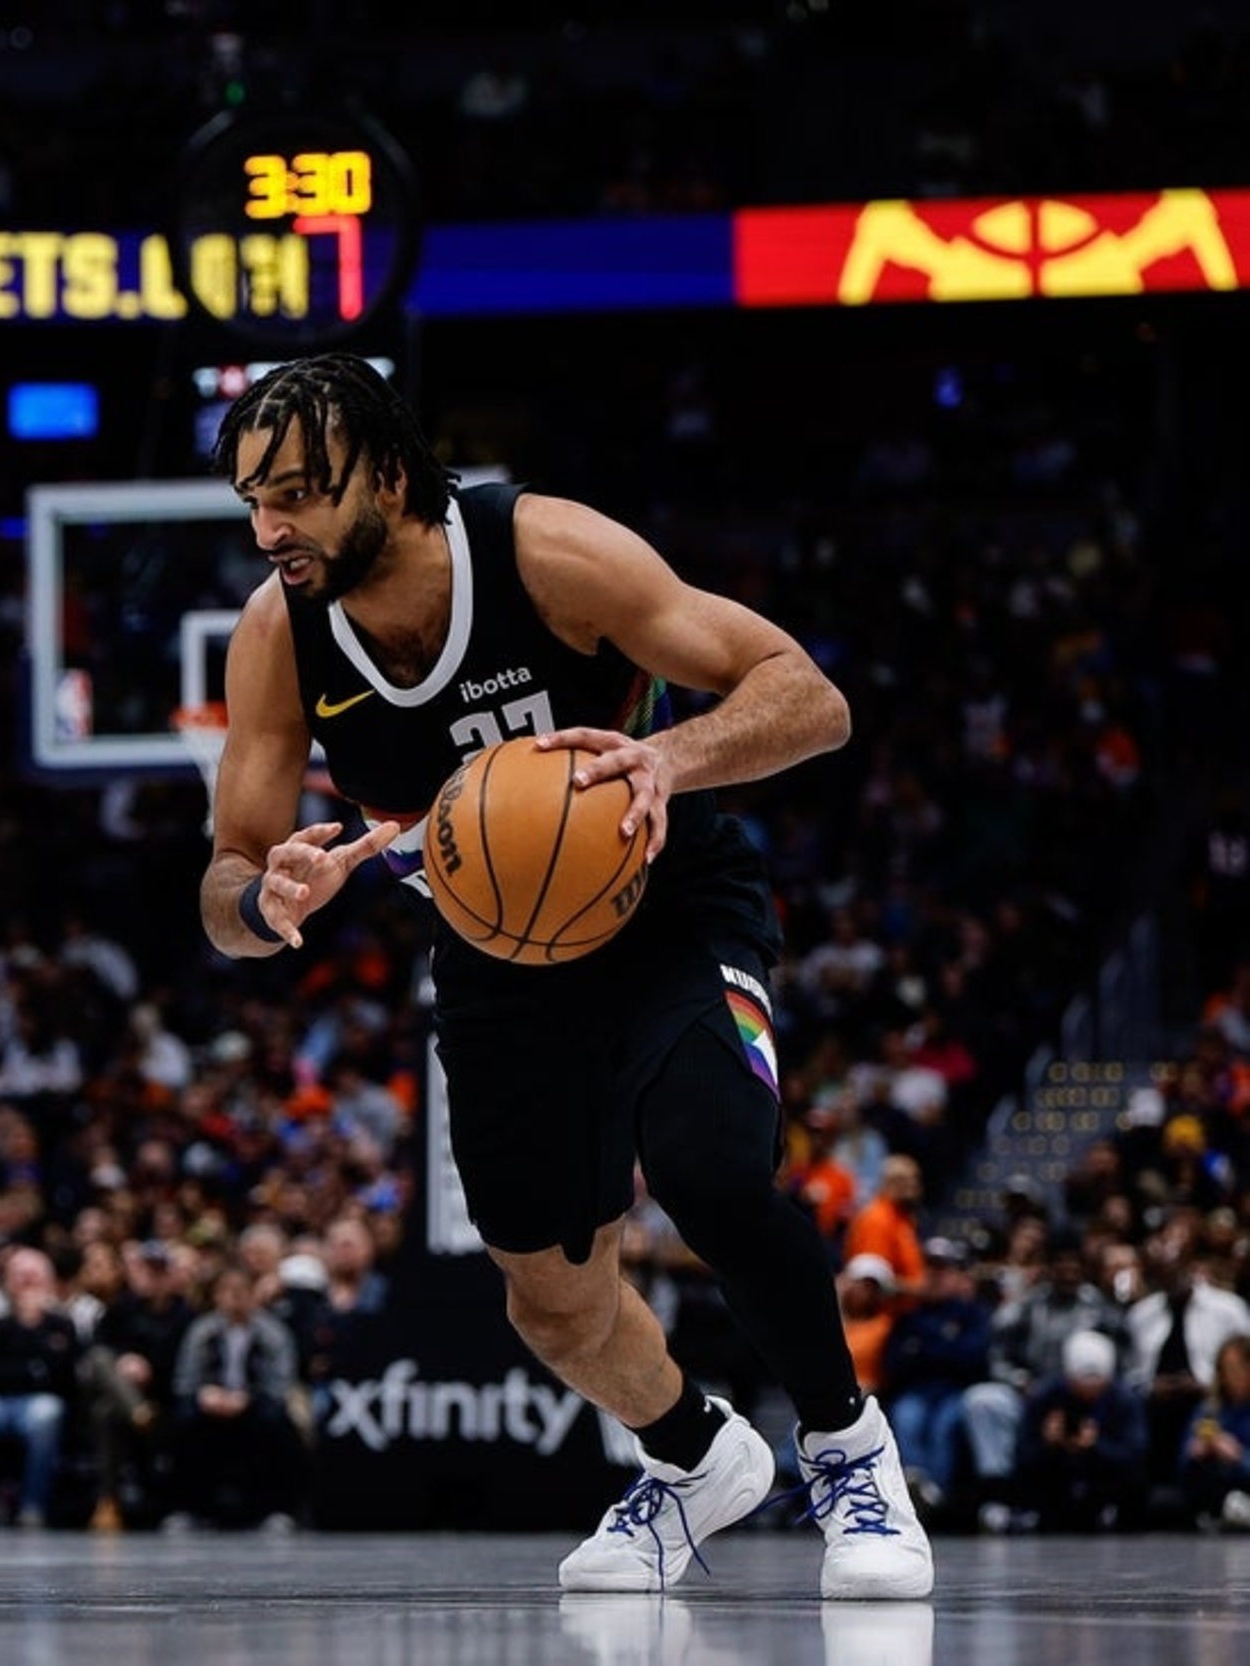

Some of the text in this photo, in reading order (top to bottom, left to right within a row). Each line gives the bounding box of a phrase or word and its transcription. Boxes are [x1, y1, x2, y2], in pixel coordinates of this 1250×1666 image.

[244, 151, 372, 218] 3:30
[293, 215, 363, 320] 7
[459, 667, 532, 702] ibotta
[328, 1359, 585, 1455] xfinity
